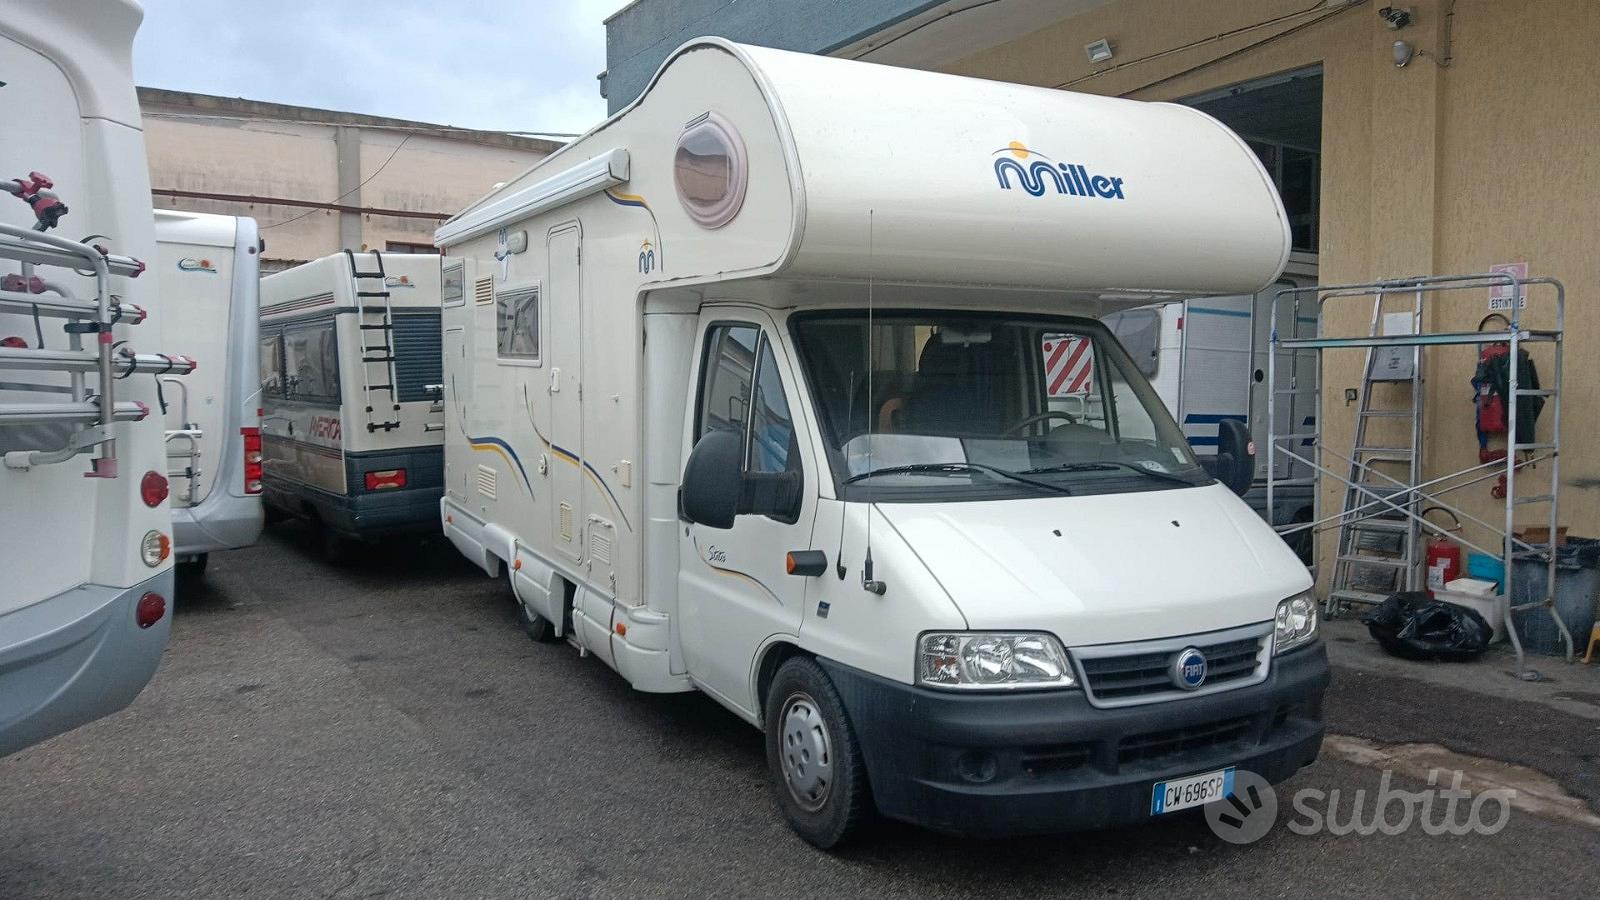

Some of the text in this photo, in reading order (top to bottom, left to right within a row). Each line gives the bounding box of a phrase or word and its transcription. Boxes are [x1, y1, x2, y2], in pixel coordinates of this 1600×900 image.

[993, 157, 1125, 200] Miller
[1491, 297, 1525, 309] ESTINTE
[1184, 663, 1204, 678] FIAT
